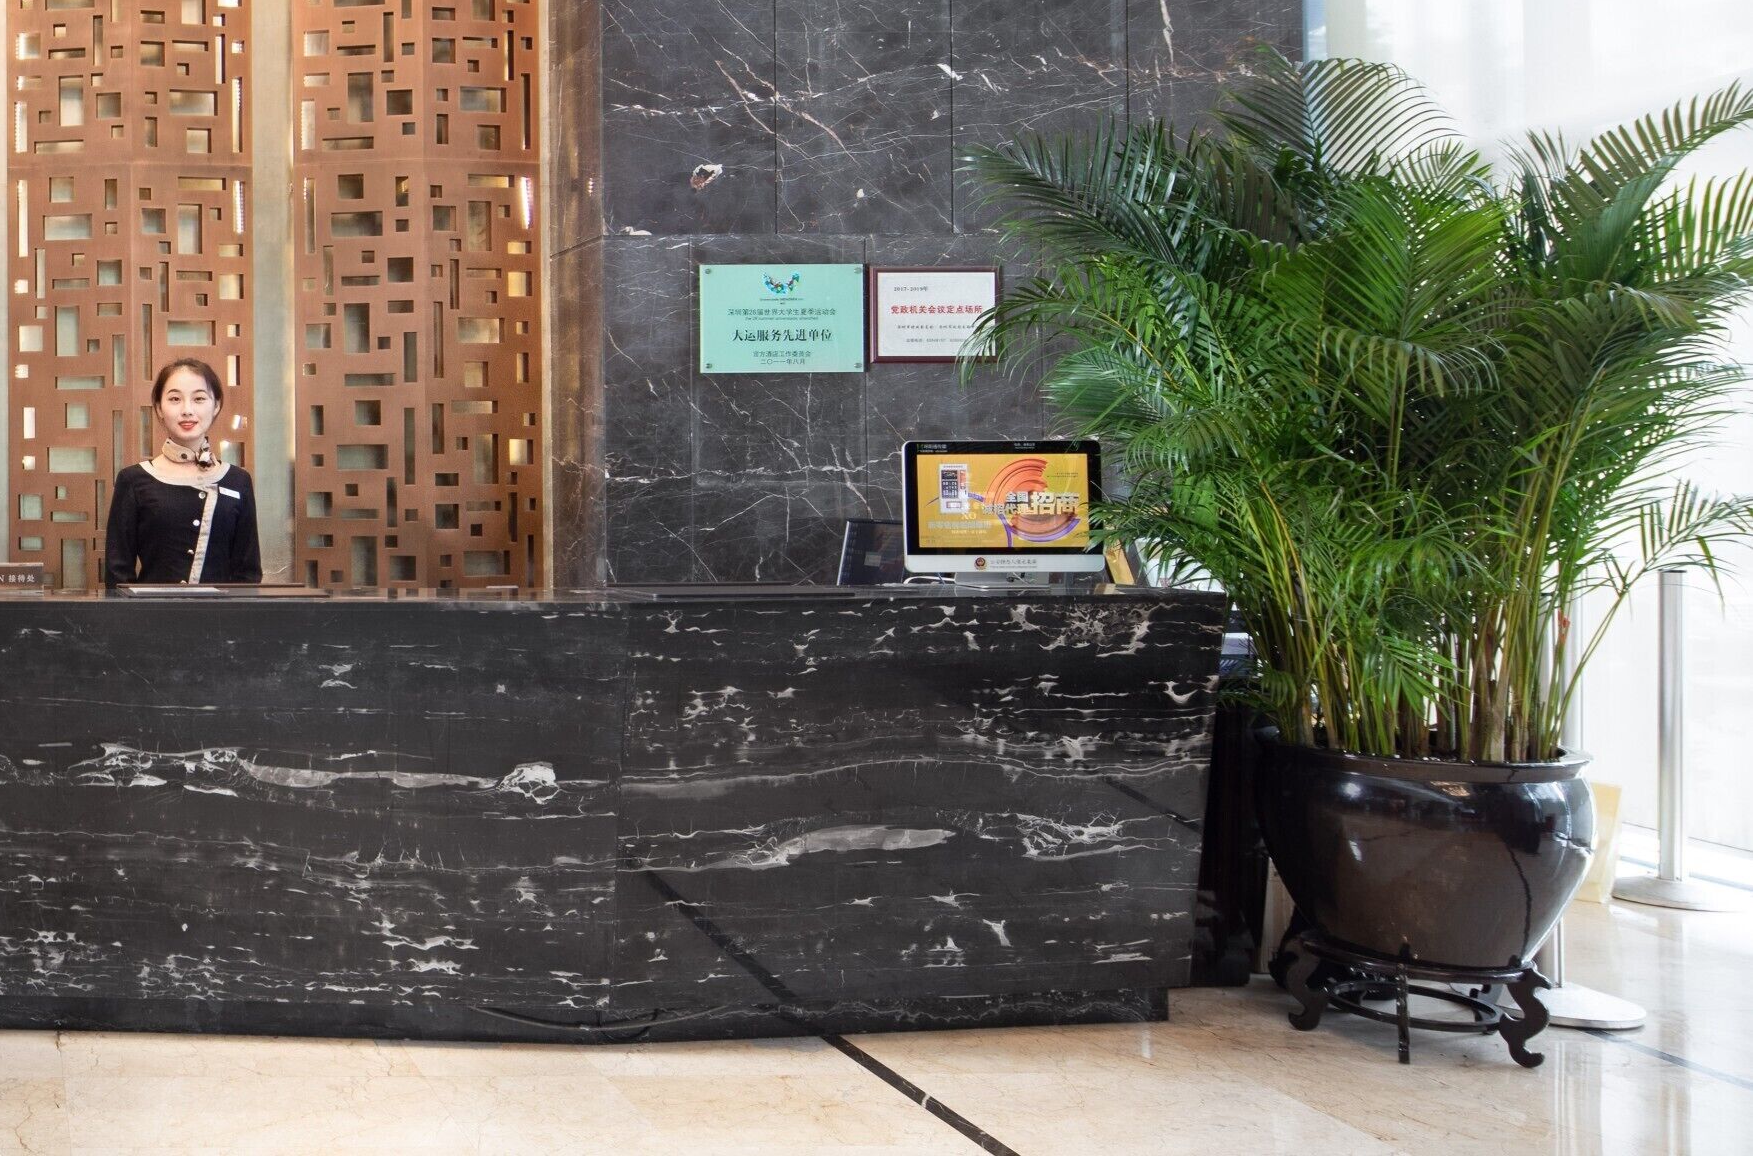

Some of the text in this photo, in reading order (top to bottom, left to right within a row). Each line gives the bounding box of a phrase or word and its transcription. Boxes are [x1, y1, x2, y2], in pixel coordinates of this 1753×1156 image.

[890, 305, 983, 314] 党政机关会议定点场所
[733, 329, 833, 342] 大运服务先进单位
[753, 350, 812, 358] 官方酒店工作委员会
[1030, 491, 1080, 515] 招商
[8, 574, 35, 583] 接待处
